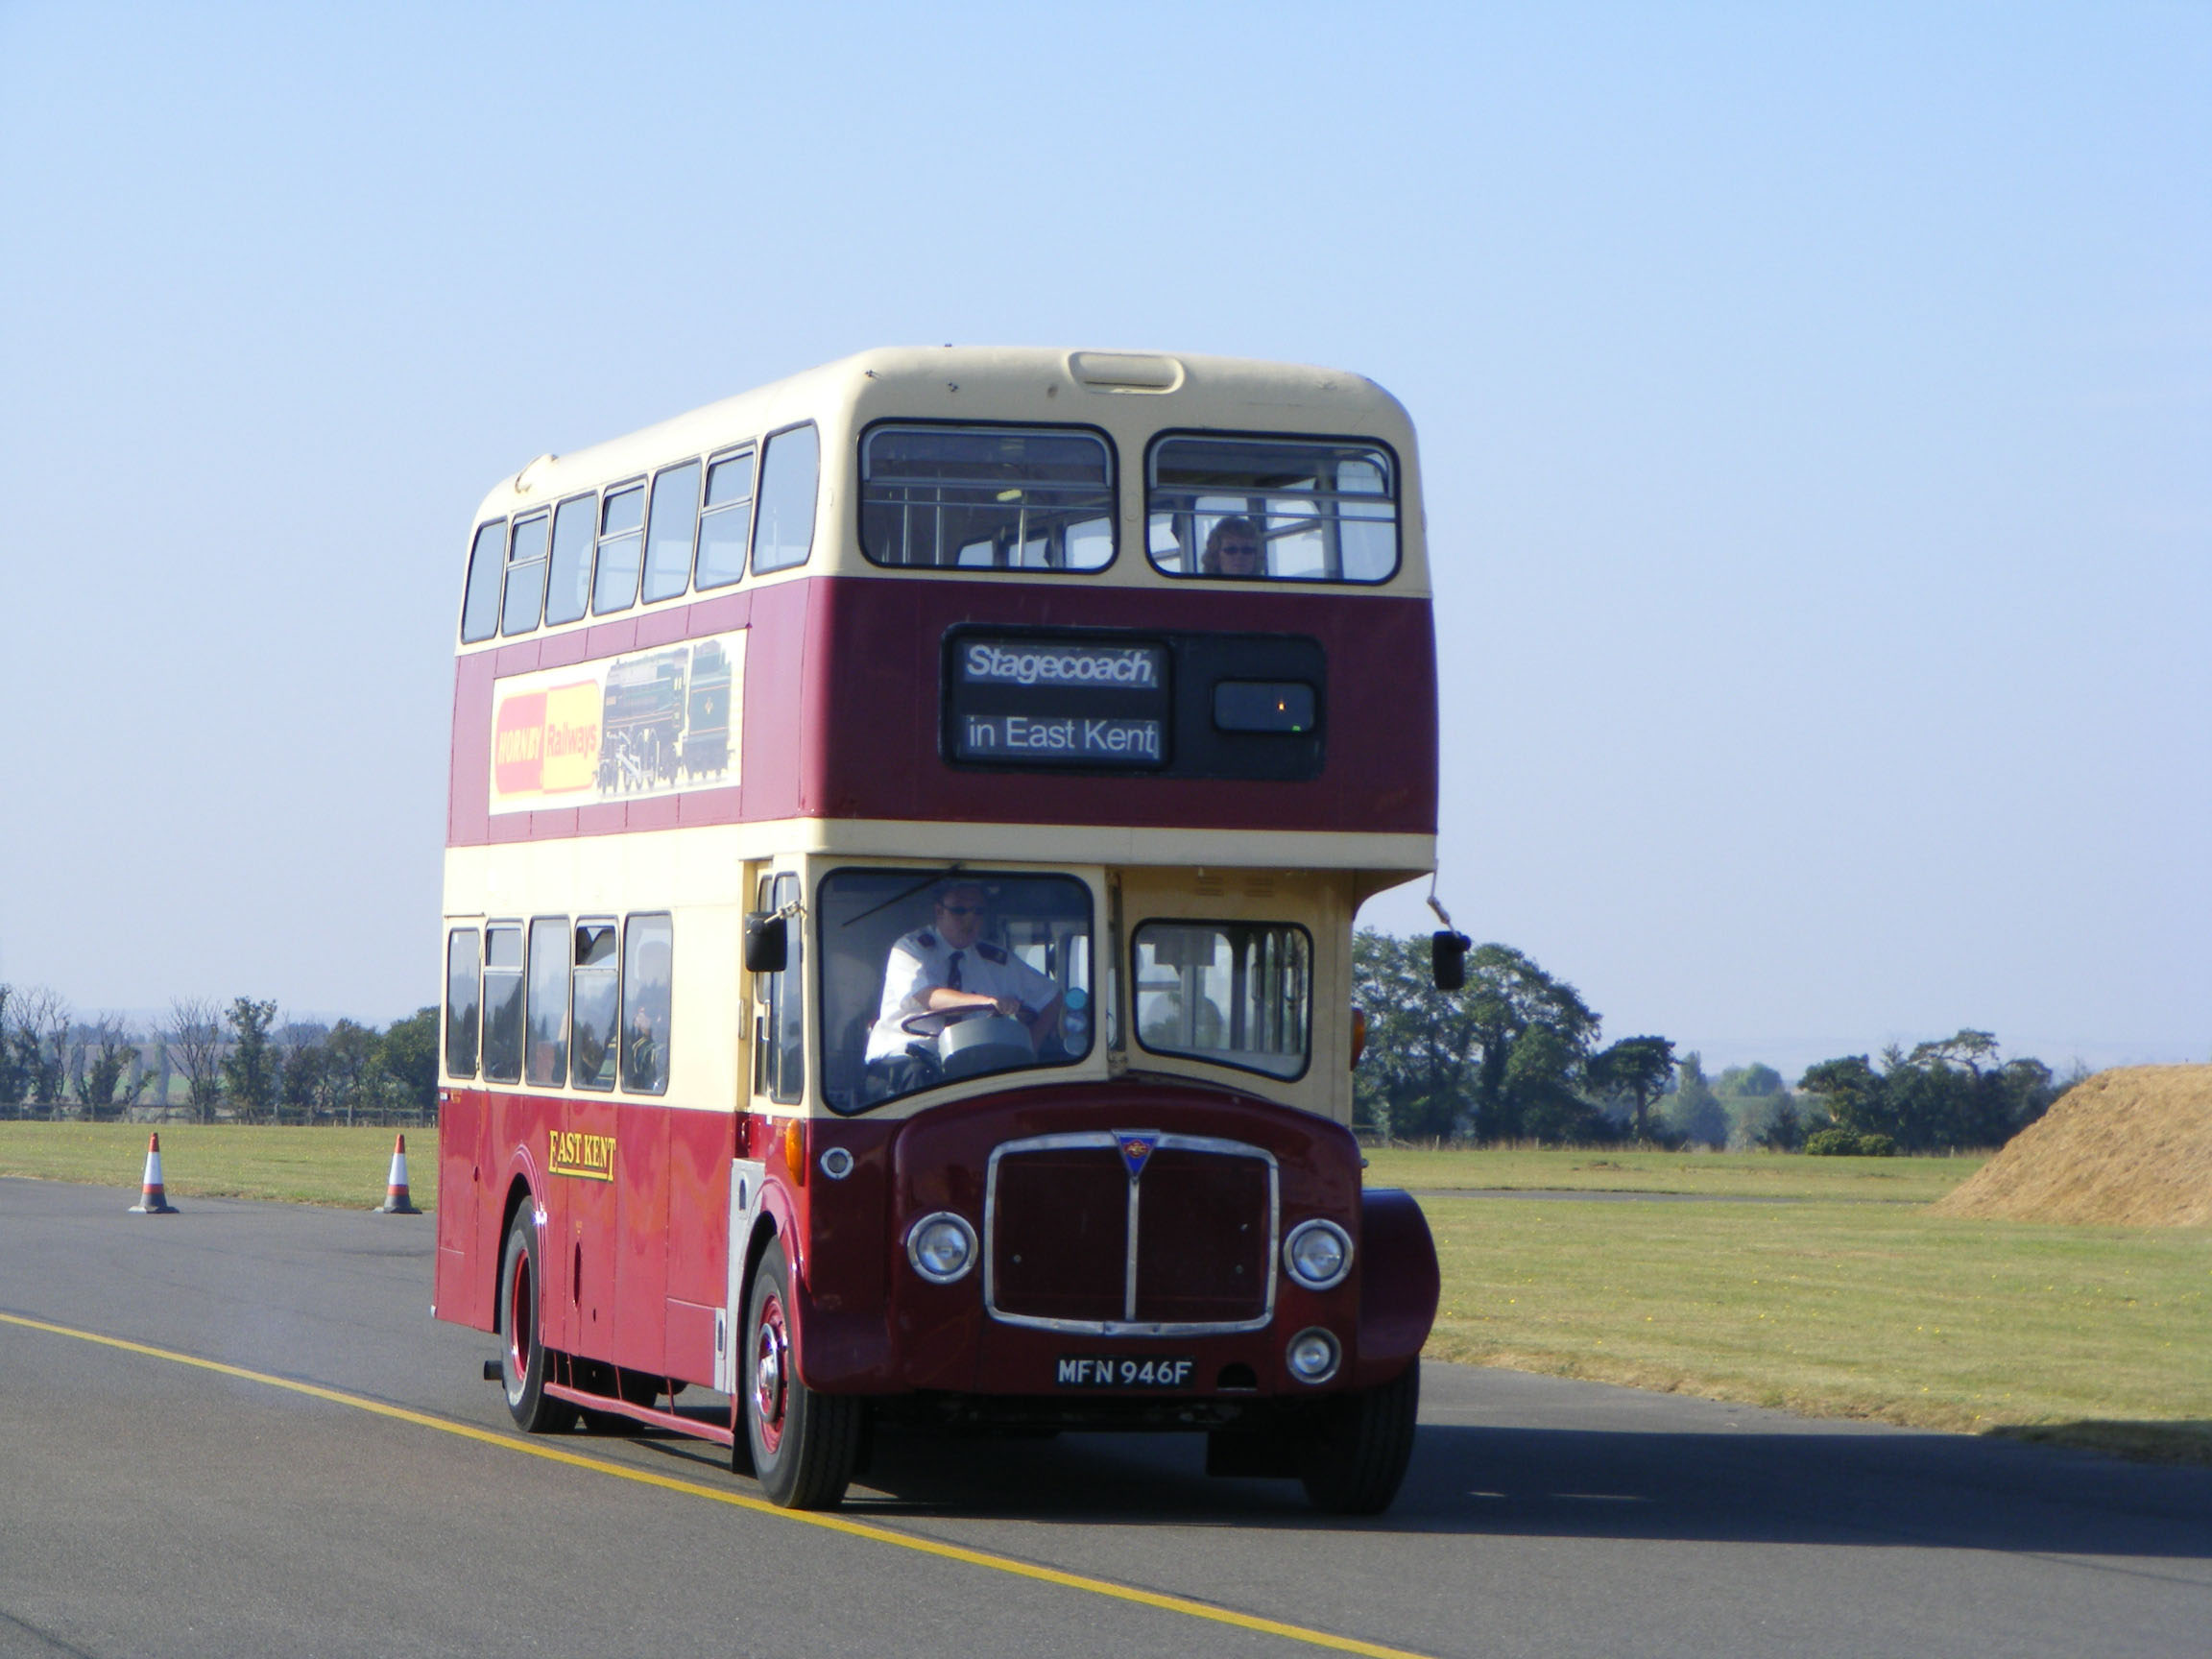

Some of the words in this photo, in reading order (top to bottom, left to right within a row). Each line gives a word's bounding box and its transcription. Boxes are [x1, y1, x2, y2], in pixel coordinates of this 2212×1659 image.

[968, 644, 1151, 684] Stagecoach
[497, 726, 541, 764] HORNBY
[546, 723, 597, 759] Railways
[969, 718, 996, 748] in
[1006, 717, 1074, 748] East
[1084, 721, 1154, 754] Kent
[548, 1130, 582, 1172] EAST
[584, 1135, 616, 1182] KENT
[1058, 1359, 1114, 1382] MFN
[1120, 1361, 1192, 1383] 946F
